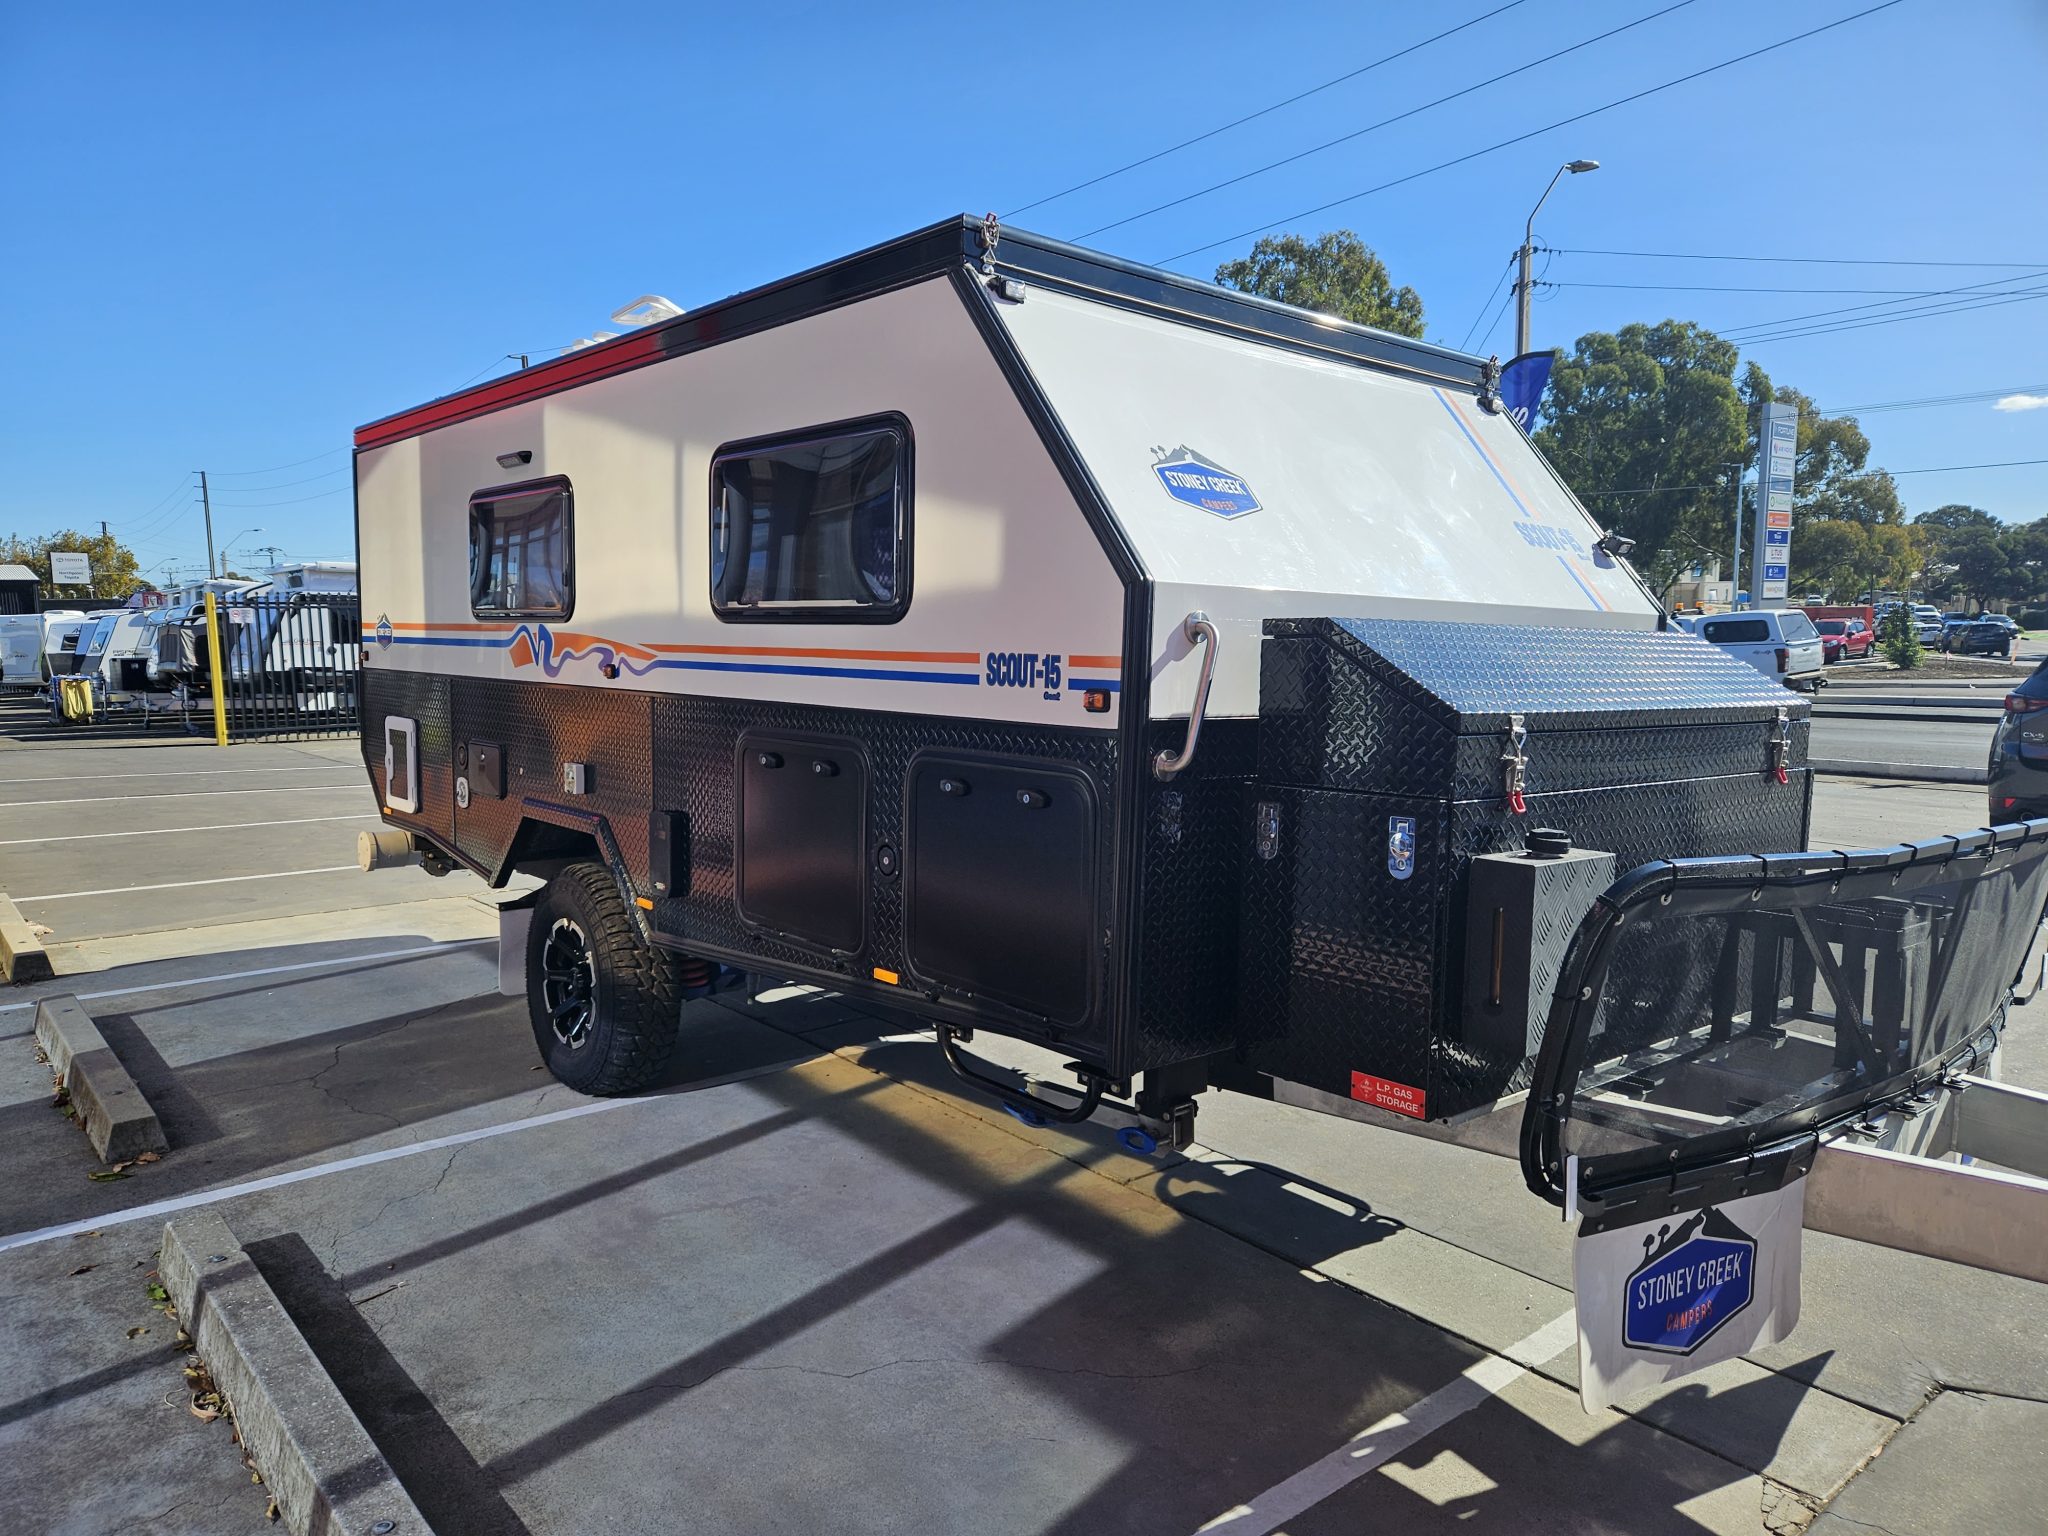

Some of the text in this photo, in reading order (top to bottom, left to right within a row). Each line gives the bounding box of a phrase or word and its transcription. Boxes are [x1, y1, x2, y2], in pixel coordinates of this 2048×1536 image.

[1165, 471, 1246, 495] STONEY CREEK
[986, 652, 1061, 690] SCOUT-15
[1376, 1082, 1391, 1094] L.P.
[1393, 1087, 1413, 1100] GAS
[1376, 1093, 1419, 1113] STORAGE
[1637, 1251, 1743, 1310] STONEY CREEK
[1666, 1299, 1713, 1332] CAMPERS
